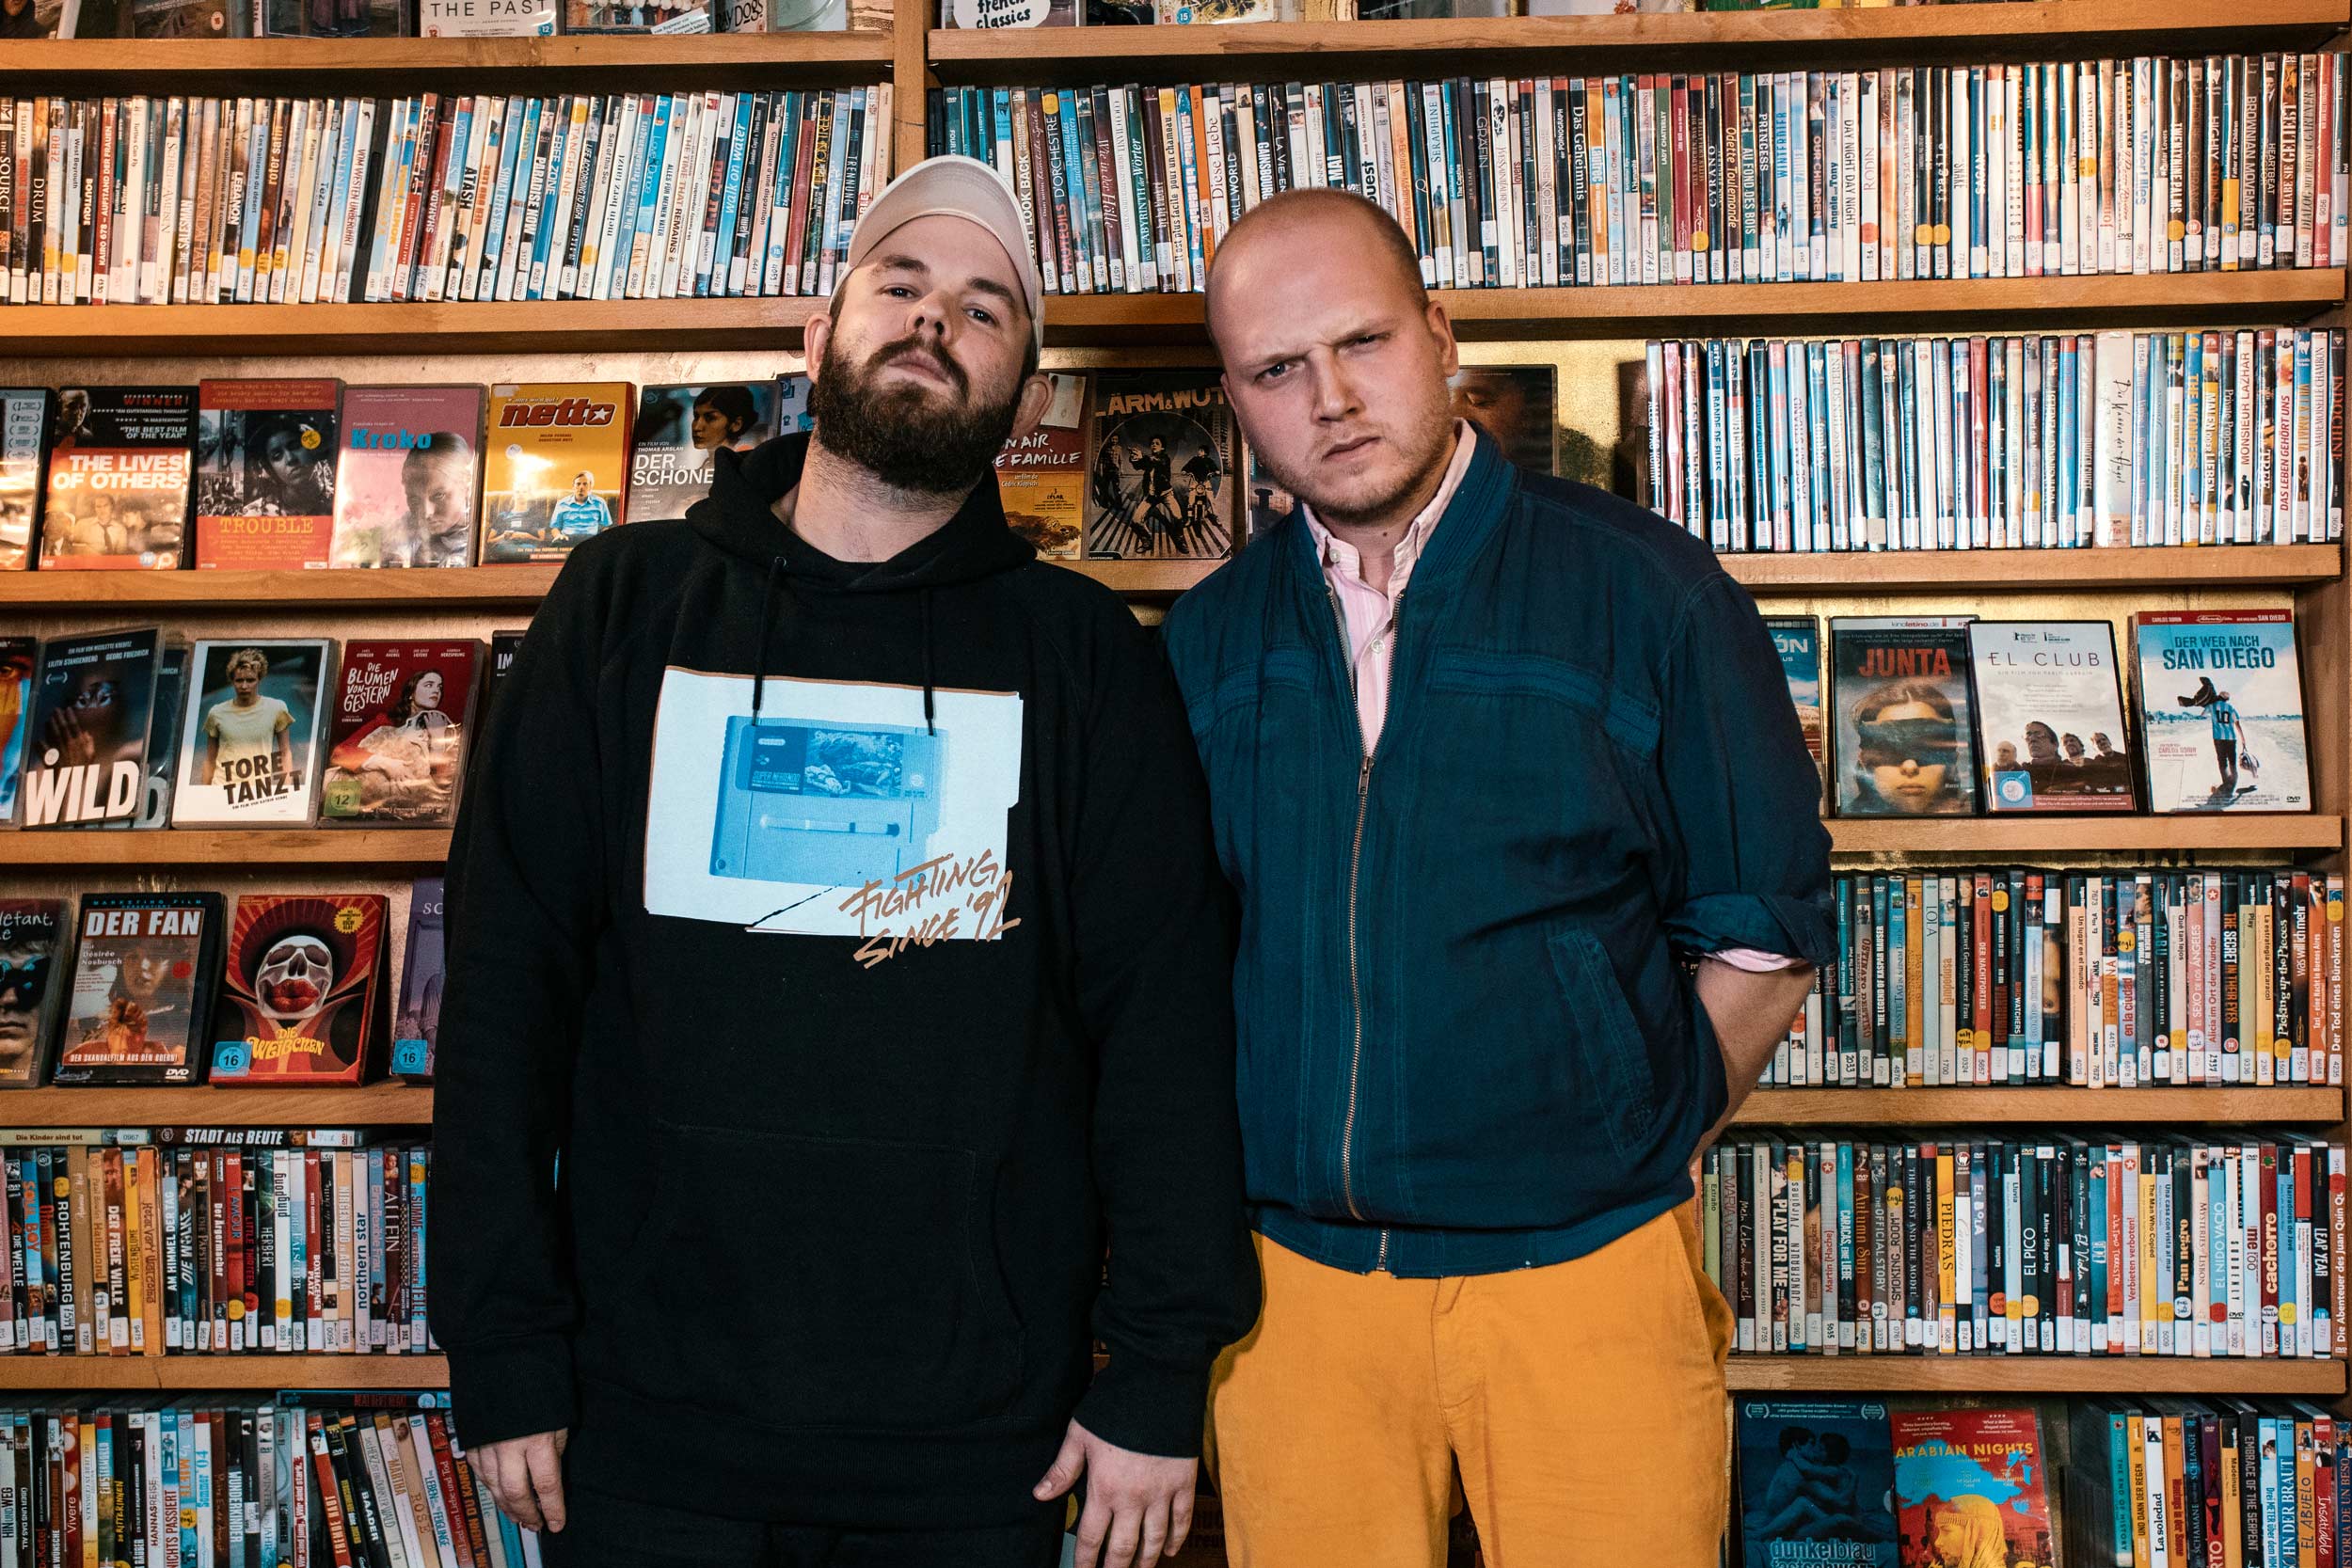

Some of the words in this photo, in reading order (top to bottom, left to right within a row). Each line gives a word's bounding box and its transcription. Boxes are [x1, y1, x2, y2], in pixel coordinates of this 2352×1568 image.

[431, 3, 474, 17] THE
[491, 0, 545, 14] PAST
[977, 0, 1025, 13] frenc
[977, 8, 1030, 28] classics
[1430, 102, 1441, 163] SERAPHINE
[1573, 106, 1582, 130] Das
[548, 135, 564, 164] FREE
[734, 123, 746, 165] water
[1206, 118, 1222, 157] Liebe
[1726, 127, 1737, 164] Odette
[1759, 113, 1770, 171] PRINCESS
[546, 166, 559, 196] ZONE
[731, 166, 739, 182] on
[844, 156, 858, 205] TRENNUNG
[1209, 163, 1225, 199] Diese
[1573, 133, 1587, 200] Geheimnis
[83, 178, 93, 226] BOUTIQUE
[229, 171, 244, 226] LEBANON
[460, 166, 478, 210] ATASH
[725, 182, 739, 214] walk
[1727, 167, 1738, 229] Toulemonde
[1813, 166, 1822, 219] CHILDREN
[178, 199, 193, 248] SALESMAN
[425, 188, 440, 233] SHAHADA
[670, 208, 682, 254] REMAINS
[1057, 203, 1073, 273] FAUTEUILS
[2240, 352, 2250, 401] LAZHAR
[499, 398, 617, 427] netto
[2332, 375, 2344, 460] INDOCHINE
[351, 428, 432, 450] Kroko
[2242, 404, 2250, 465] MONSIEUR
[70, 455, 113, 471] THE
[119, 455, 183, 471] LIVES
[632, 465, 714, 485] SCHÖNE
[635, 454, 675, 470] DER
[53, 473, 85, 490] OF
[219, 516, 314, 534] TROUBLE
[2175, 636, 2197, 648] DER
[2201, 636, 2226, 647] WEG
[2229, 636, 2259, 647] NACH
[367, 662, 381, 672] DIE
[1858, 648, 1952, 678] JUNTA
[1988, 652, 2017, 666] EL
[2034, 652, 2100, 666] CLUB
[2163, 648, 2204, 670] SAN
[2210, 647, 2275, 669] DIEGO
[347, 668, 399, 685] BLUMEN
[347, 685, 365, 694] VON
[343, 684, 391, 713] GESTERN
[221, 752, 283, 782] TORE
[25, 760, 139, 827] WILD
[224, 770, 302, 805] TANZT
[335, 794, 349, 805] 12
[838, 848, 999, 940] FIGHTING
[86, 911, 140, 937] DER
[148, 911, 200, 936] FAN
[1925, 905, 1937, 938] LOLA
[853, 907, 959, 969] SINCE
[2331, 927, 2342, 982] Bürokraten
[2332, 985, 2342, 1006] eines
[2331, 1009, 2342, 1031] Tod
[402, 1053, 416, 1064] 16
[2331, 1034, 2342, 1052] Der
[223, 1054, 239, 1067] 16
[184, 1129, 222, 1145] STADT
[225, 1132, 245, 1145] ALS
[246, 1130, 283, 1145] BEUTE
[108, 1205, 119, 1228] DER
[357, 1212, 367, 1242] star
[384, 1191, 400, 1252] ALLEIN
[1772, 1198, 1787, 1228] PLAY
[109, 1231, 121, 1267] FREIE
[262, 1227, 274, 1268] HERBERT
[1773, 1230, 1788, 1254] FOR
[1941, 1202, 1953, 1272] PIEDRAS
[2023, 1227, 2036, 1256] PICO
[2336, 1233, 2344, 1254] Juan
[56, 1200, 72, 1306] ROHTENBURG
[2024, 1260, 2036, 1276] EL
[2265, 1212, 2279, 1294] cachorro
[2336, 1257, 2345, 1273] des
[13, 1251, 24, 1287] WELLE
[356, 1245, 368, 1309] northern
[1773, 1256, 1788, 1288] ME
[110, 1269, 124, 1306] WILLE
[2336, 1275, 2345, 1323] Abenteuer
[2337, 1325, 2345, 1343] Die
[1896, 1443, 1967, 1459] ARABIAN
[1974, 1442, 2034, 1457] NIGHTS
[2244, 1435, 2254, 1477] EMBRACE
[67, 1497, 76, 1534] Vivere
[360, 1490, 379, 1542] BAADER
[2153, 1492, 2163, 1537] soledad
[2247, 1492, 2256, 1511] THE
[2155, 1539, 2164, 1552] La
[2248, 1513, 2258, 1551] SERPENT
